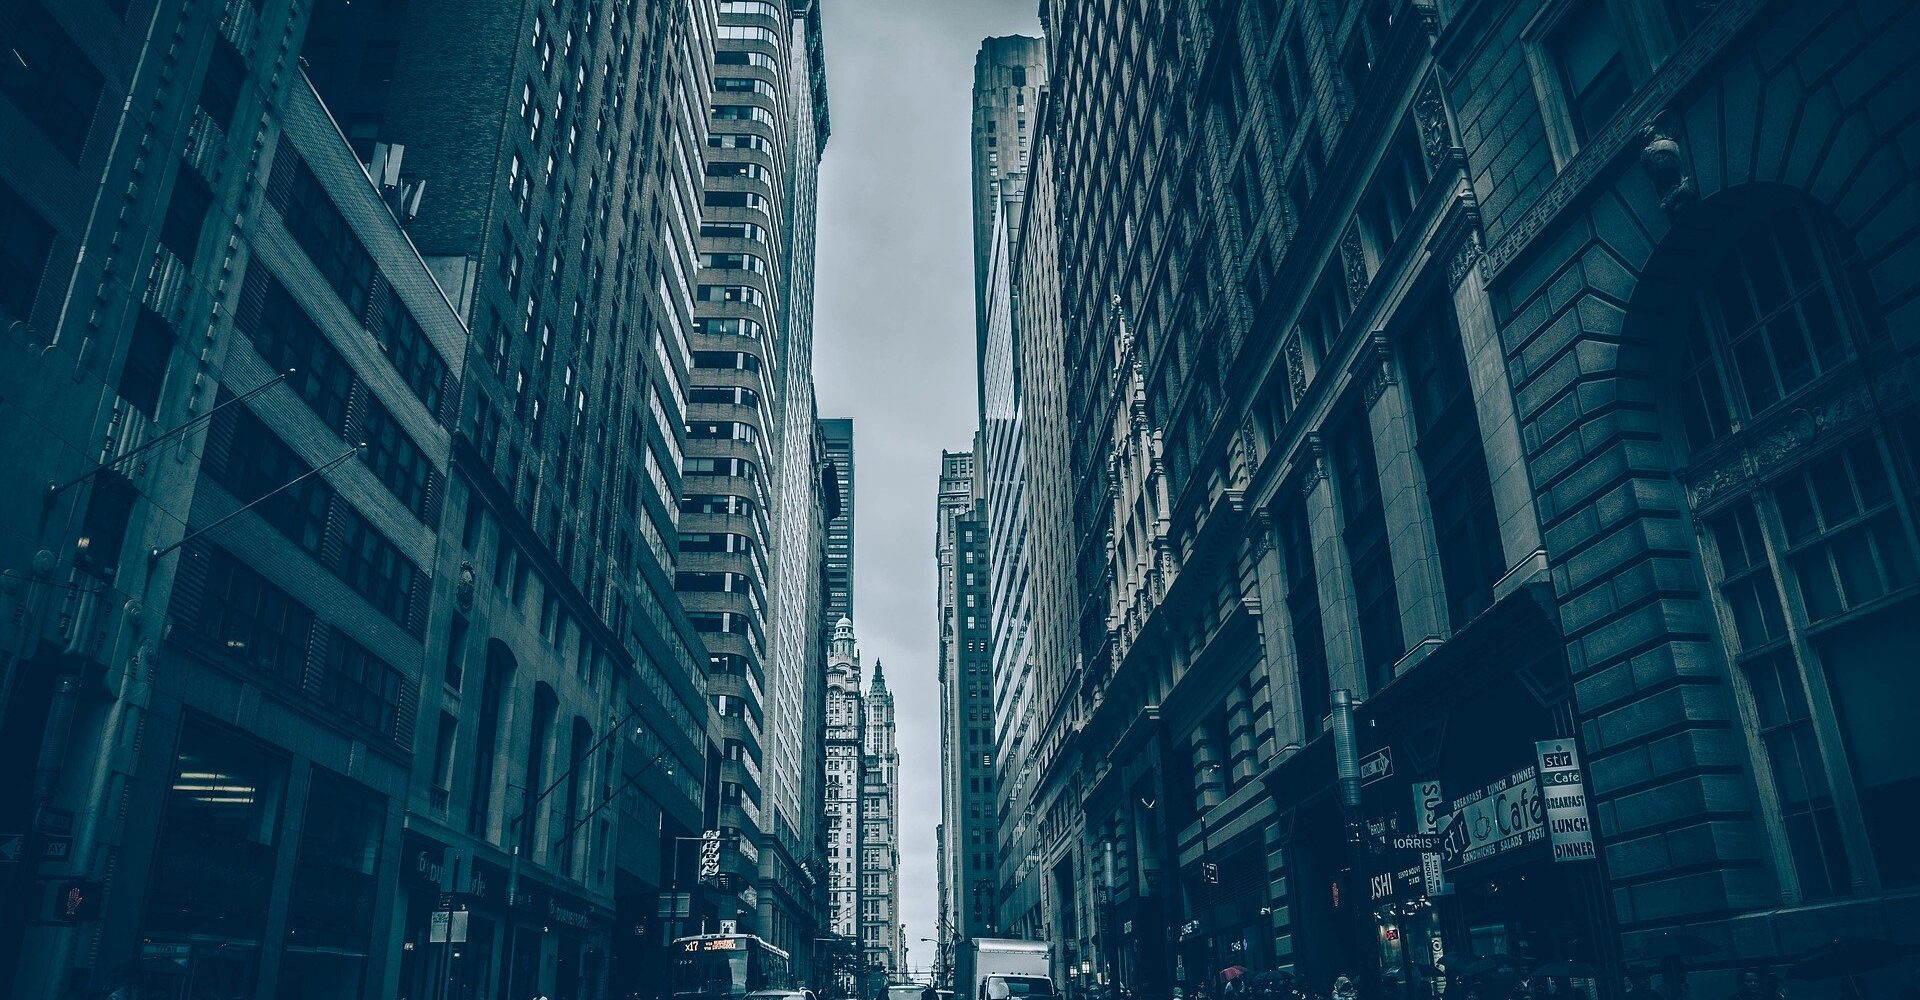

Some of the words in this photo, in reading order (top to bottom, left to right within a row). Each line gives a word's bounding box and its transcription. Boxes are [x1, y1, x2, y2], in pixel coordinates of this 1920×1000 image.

[1453, 789, 1482, 811] BREAKFAST
[1486, 778, 1507, 796] LUNCH
[1511, 765, 1536, 786] DINNER
[1546, 795, 1585, 810] BREAKFAST
[1552, 818, 1588, 834] LUNCH
[1462, 843, 1496, 864] SANDWICHES
[1500, 834, 1523, 852] SALADS
[1554, 842, 1595, 858] DINNER
